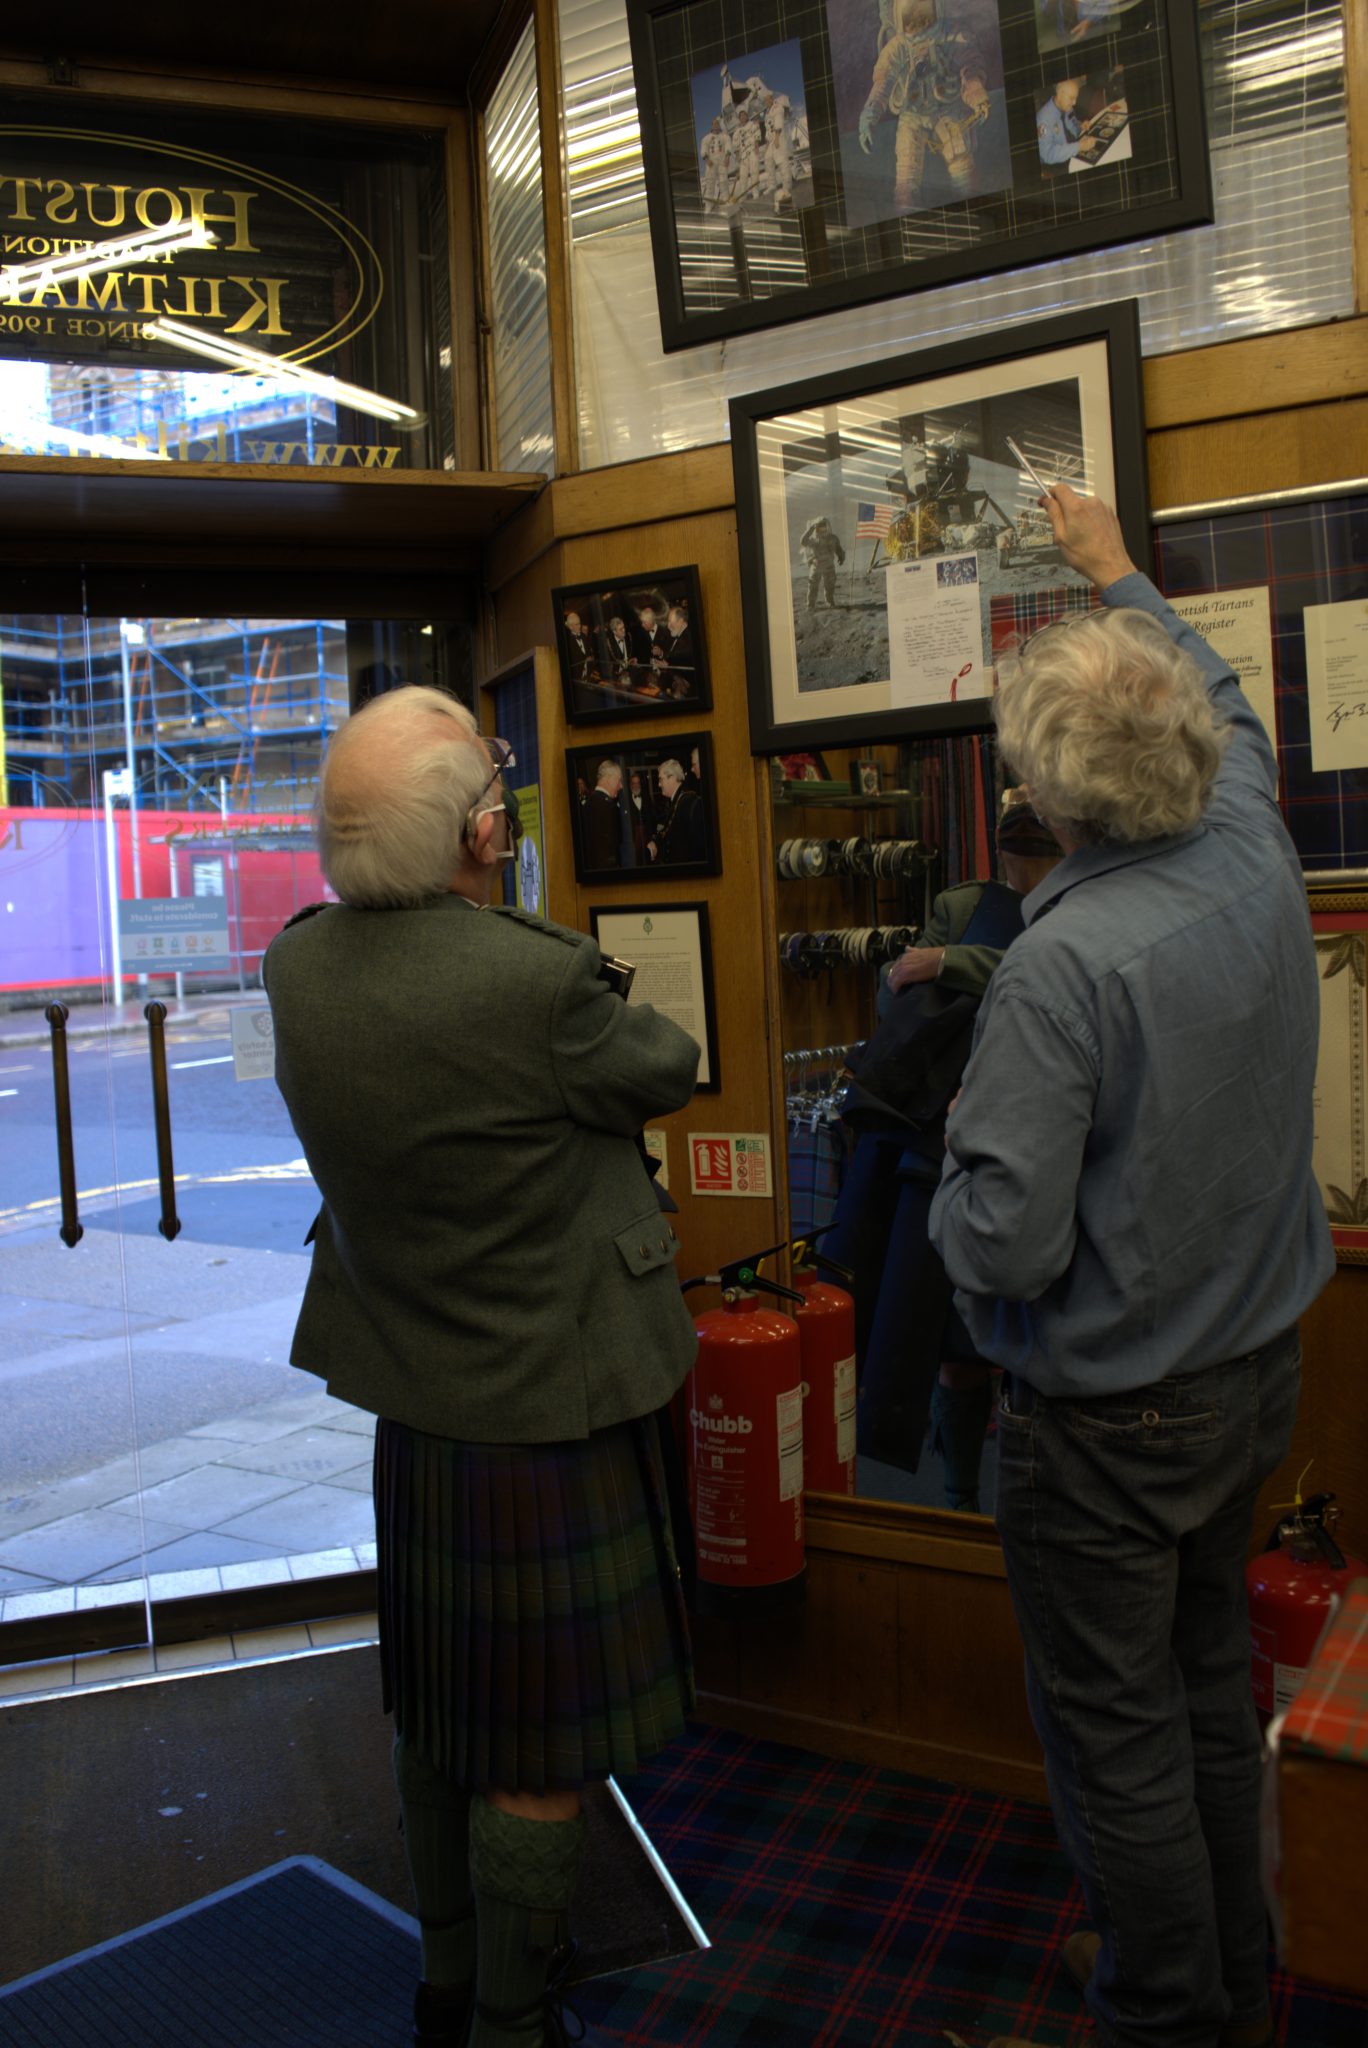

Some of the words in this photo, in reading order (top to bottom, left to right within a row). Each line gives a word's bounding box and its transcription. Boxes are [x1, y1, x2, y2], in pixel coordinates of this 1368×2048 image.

[1211, 598, 1255, 613] Tartans
[1192, 618, 1236, 633] Register
[689, 1407, 753, 1435] Chubb
